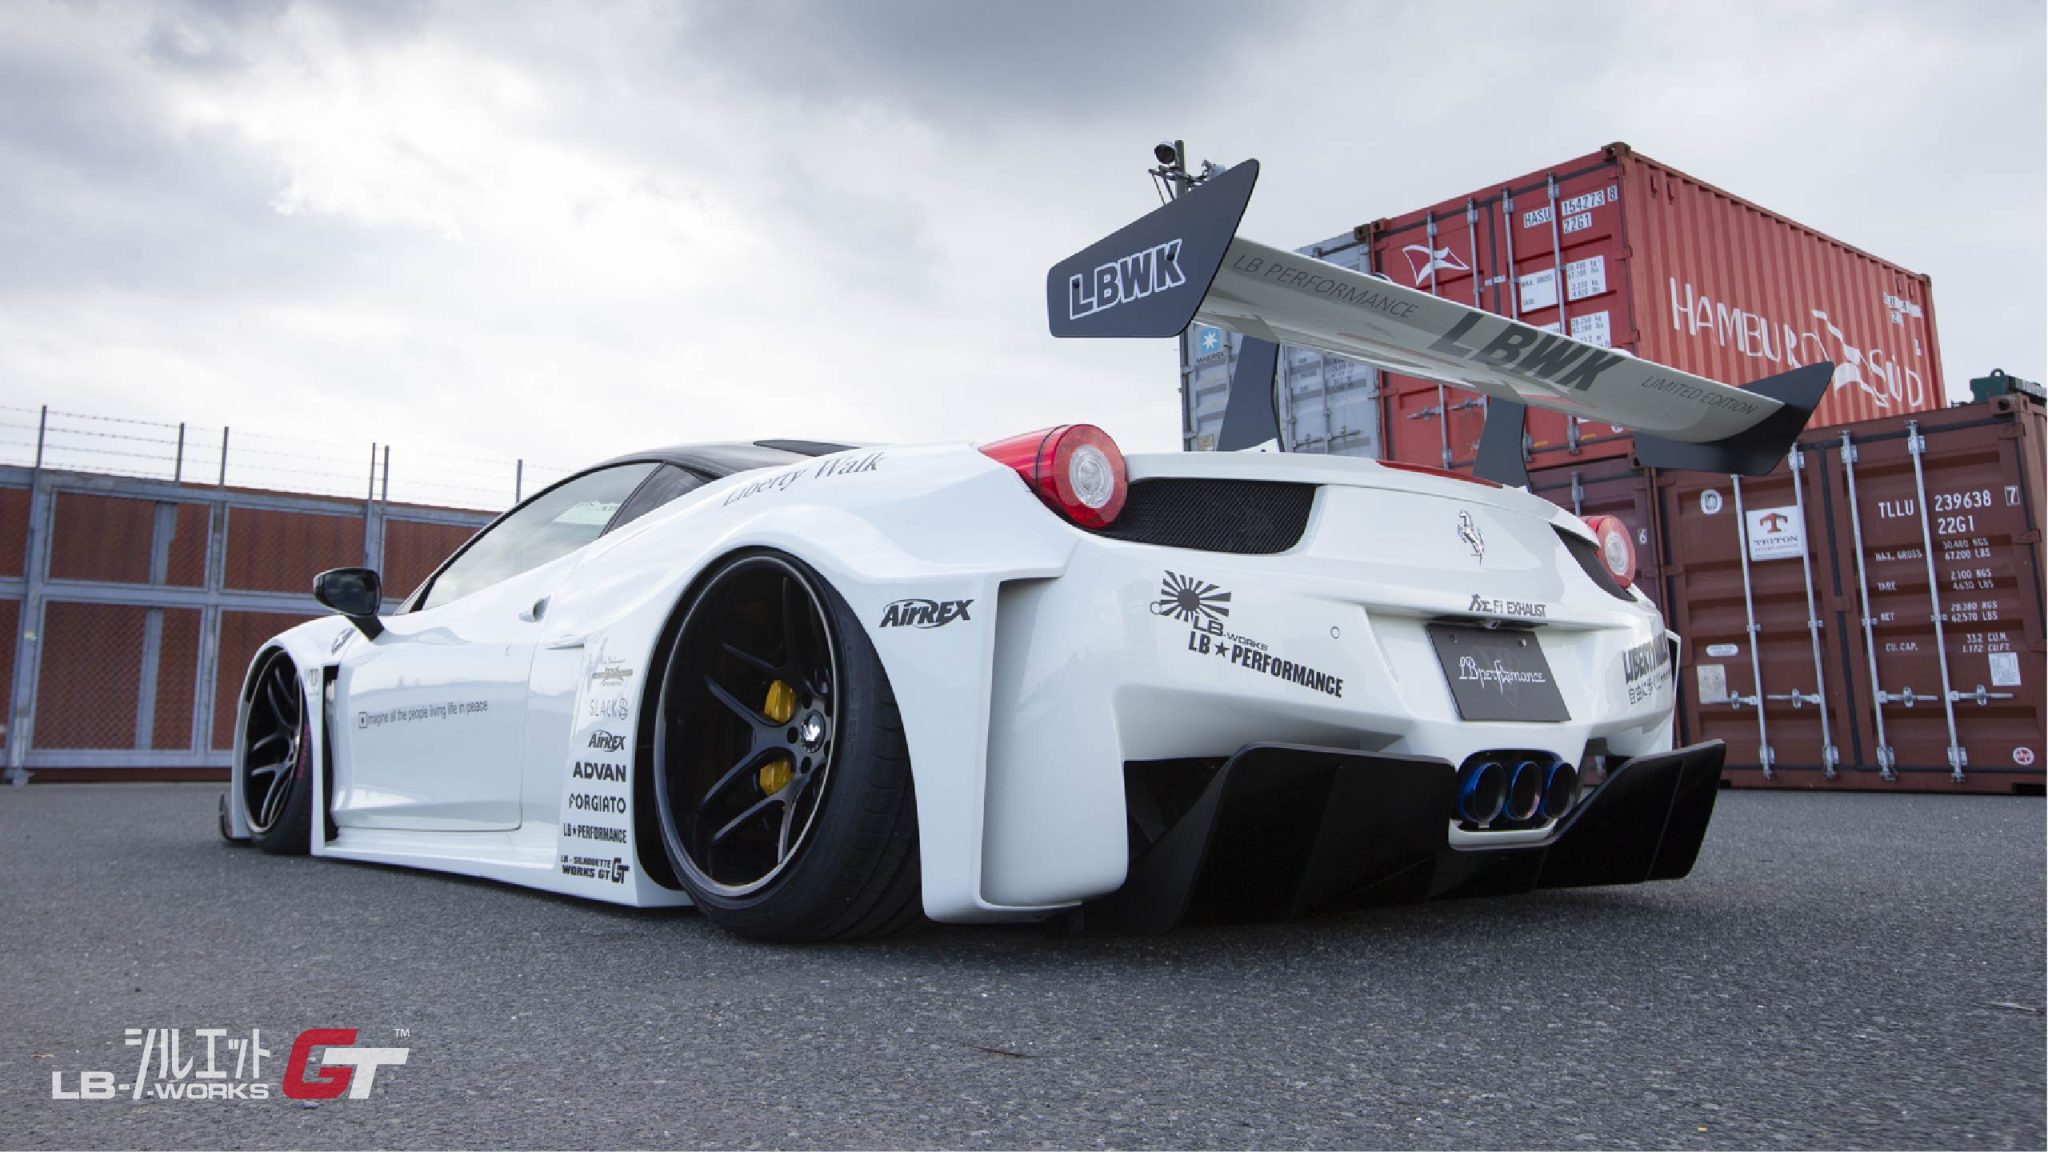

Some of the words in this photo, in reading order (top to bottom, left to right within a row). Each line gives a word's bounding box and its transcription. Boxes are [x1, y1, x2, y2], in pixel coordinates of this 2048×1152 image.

[1525, 209, 1551, 226] HASU
[1564, 191, 1603, 214] 154273
[1069, 239, 1187, 320] LBWK
[1233, 252, 1263, 274] LB
[1267, 263, 1420, 319] PERFORMANCE
[1428, 311, 1626, 392] LBWK
[1642, 374, 1703, 402] LIMITED
[1702, 389, 1758, 416] EDITION
[723, 469, 806, 507] Liberty
[815, 451, 887, 479] Walk
[1878, 499, 1915, 519] TLLU
[1934, 489, 1992, 512] 239638
[1938, 515, 1974, 535] 22G1
[1507, 601, 1546, 618] EXHAUST
[466, 700, 488, 715] peace
[573, 761, 627, 783] ADVAN
[569, 793, 627, 815] FORGIATO
[562, 864, 595, 879] WORKS
[598, 869, 611, 881] GT
